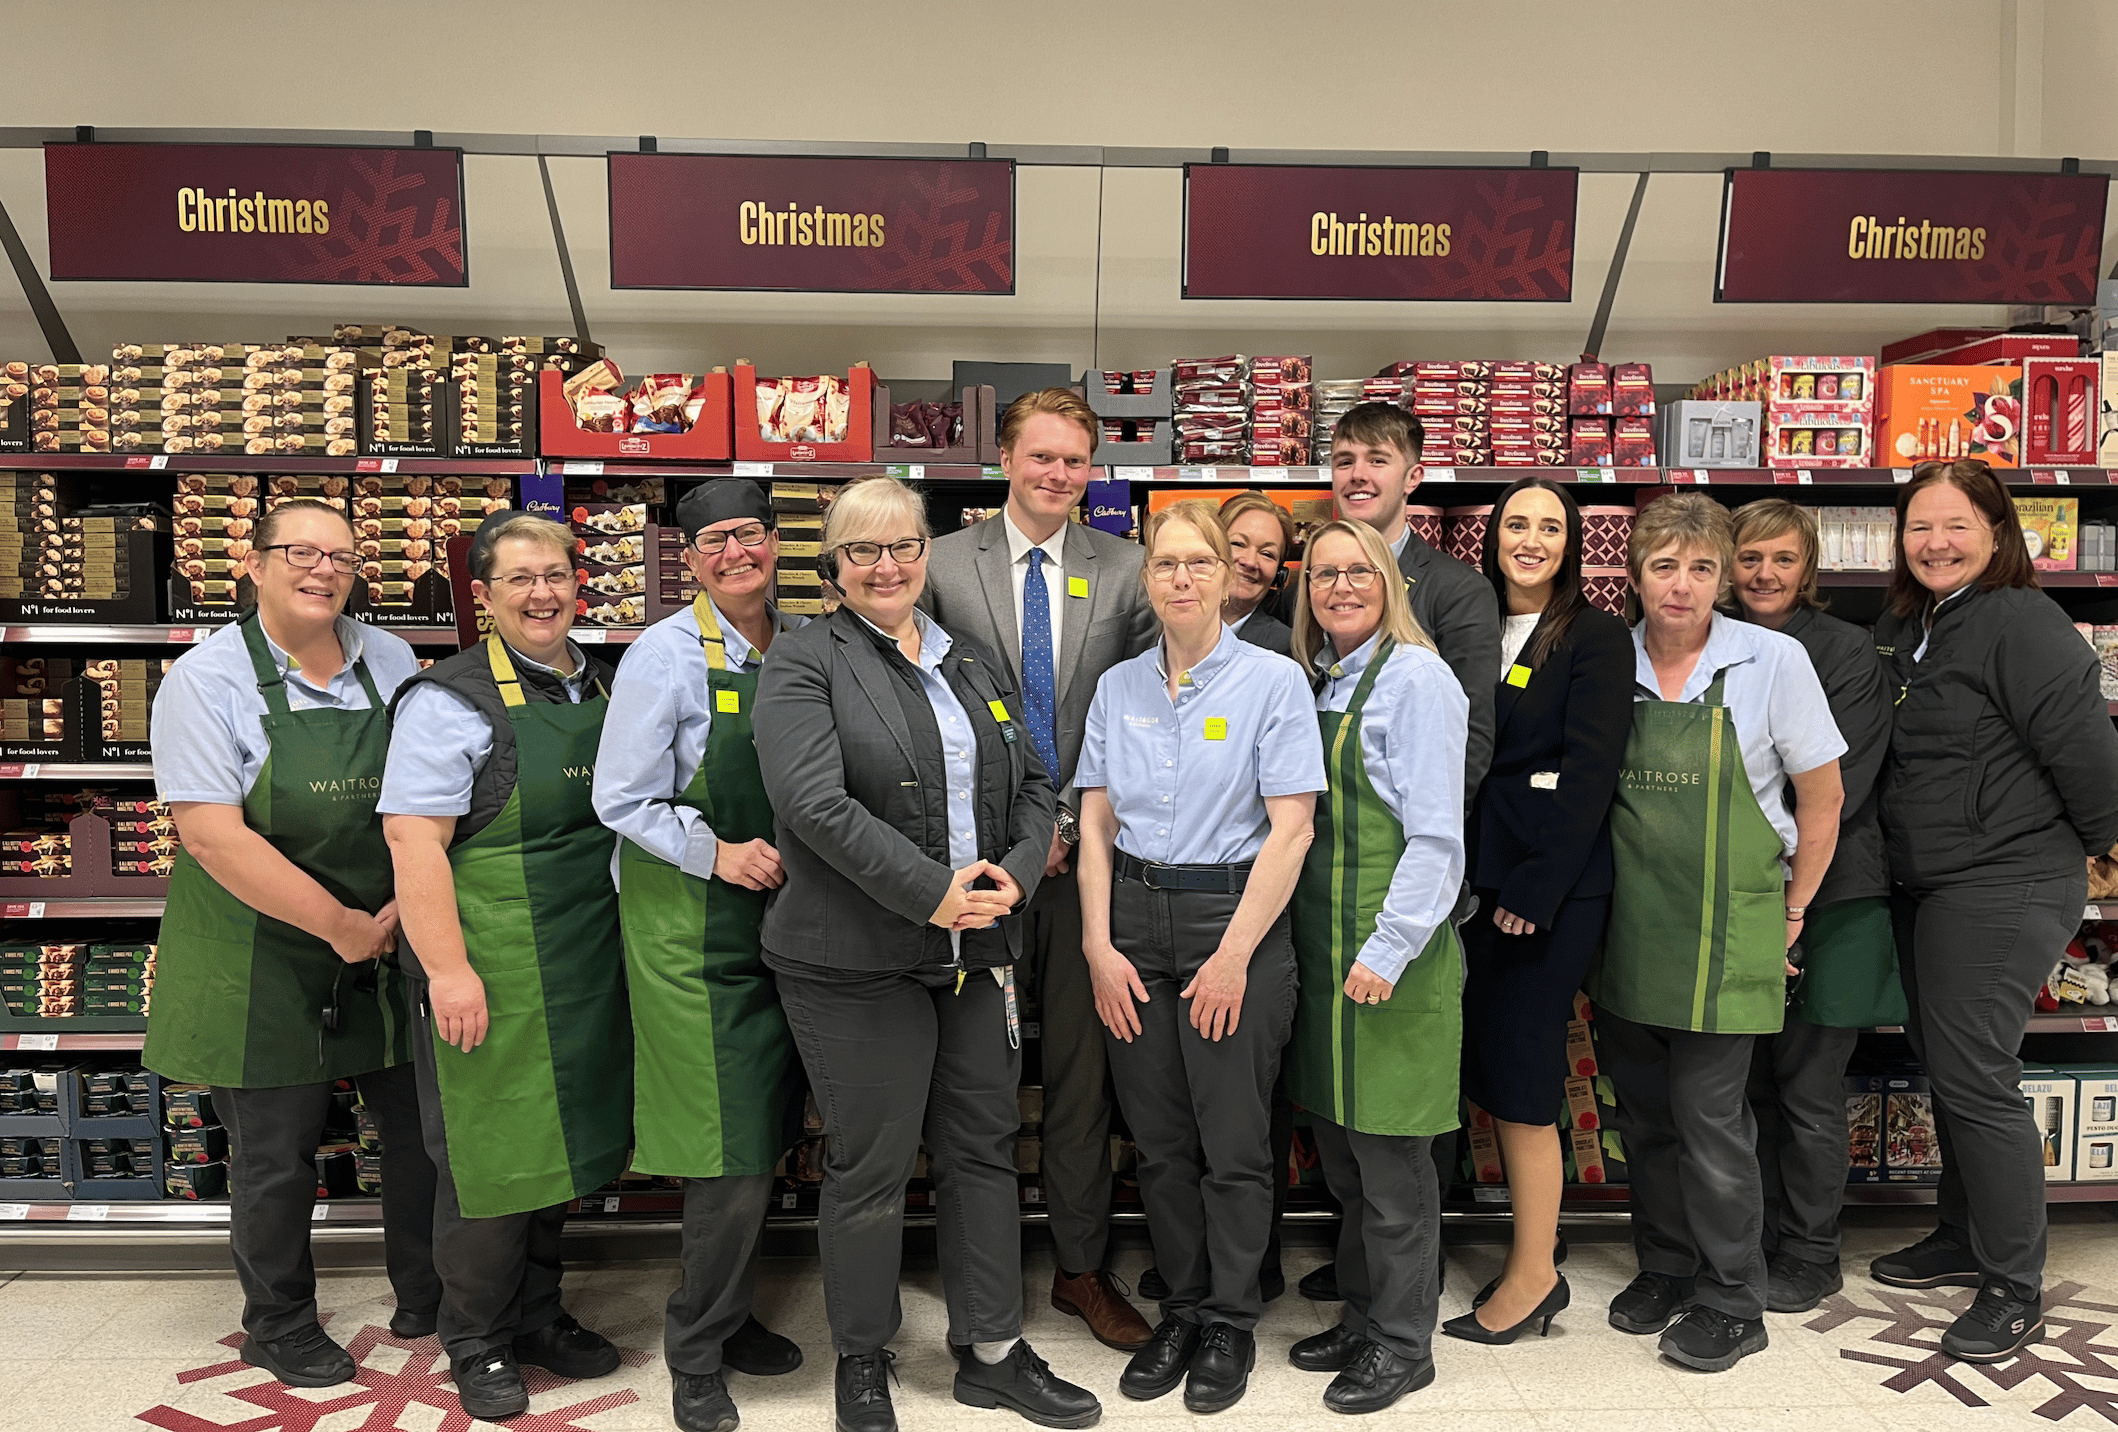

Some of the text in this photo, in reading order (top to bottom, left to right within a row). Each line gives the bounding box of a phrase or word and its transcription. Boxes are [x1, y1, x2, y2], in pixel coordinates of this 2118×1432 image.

[178, 188, 329, 234] Christmas
[739, 201, 884, 248] Christmas
[1310, 212, 1451, 257] Christmas
[1848, 215, 1986, 260] Christmas
[1910, 378, 1969, 387] SANCTUARY
[526, 500, 560, 513] Cadbury
[1094, 505, 1126, 517] Cadbury
[309, 777, 380, 792] WAITRO
[1635, 784, 1678, 792] PARTNERS
[2105, 1084, 2118, 1092] BEL
